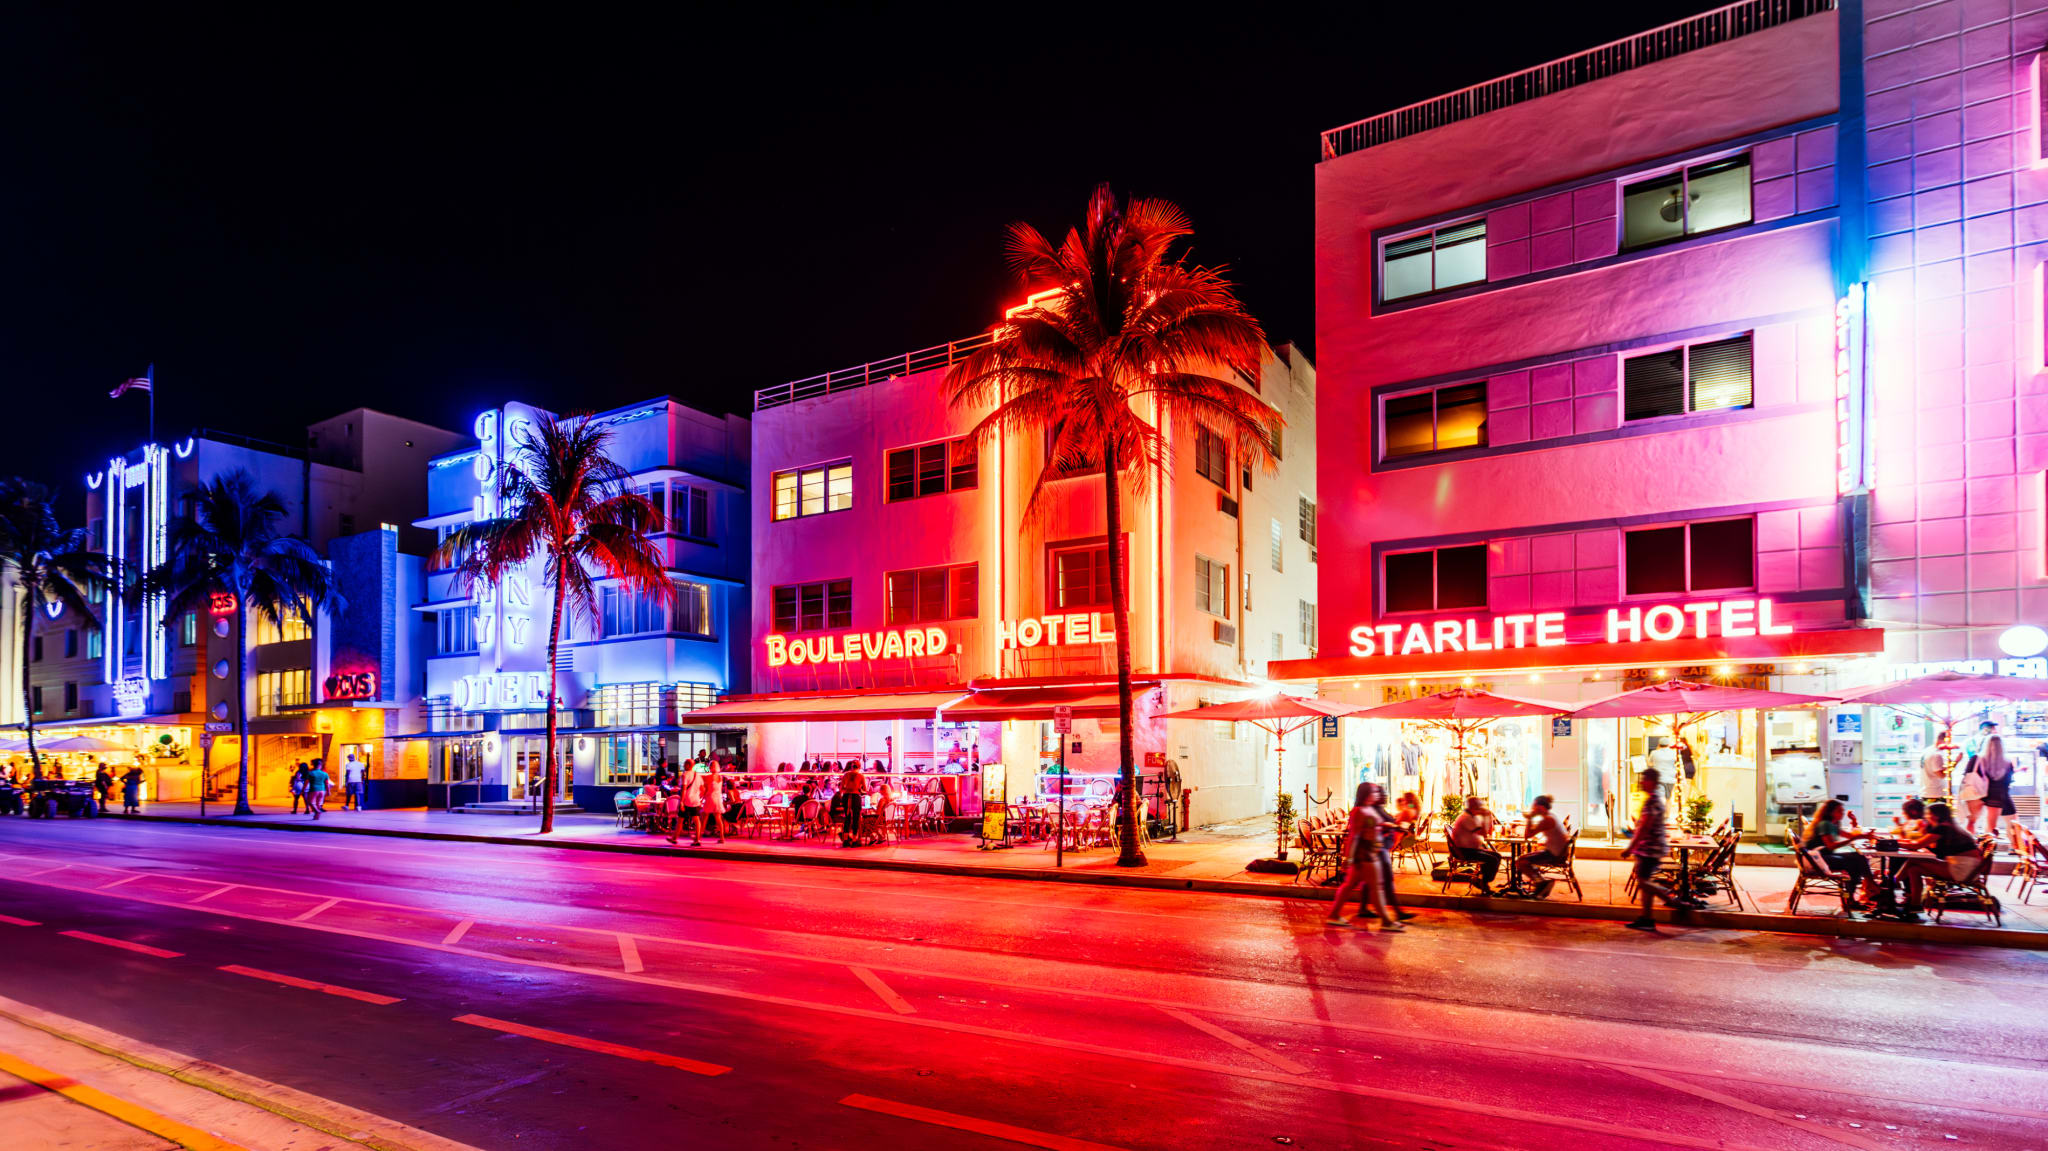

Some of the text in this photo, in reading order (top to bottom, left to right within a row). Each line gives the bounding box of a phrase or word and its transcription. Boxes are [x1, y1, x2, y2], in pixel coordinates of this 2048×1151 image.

[766, 612, 1116, 667] BOULEVARD HOTEL
[1349, 598, 1793, 657] STARLITE HOTEL
[340, 672, 375, 697] CVS
[454, 675, 547, 706] OTEL
